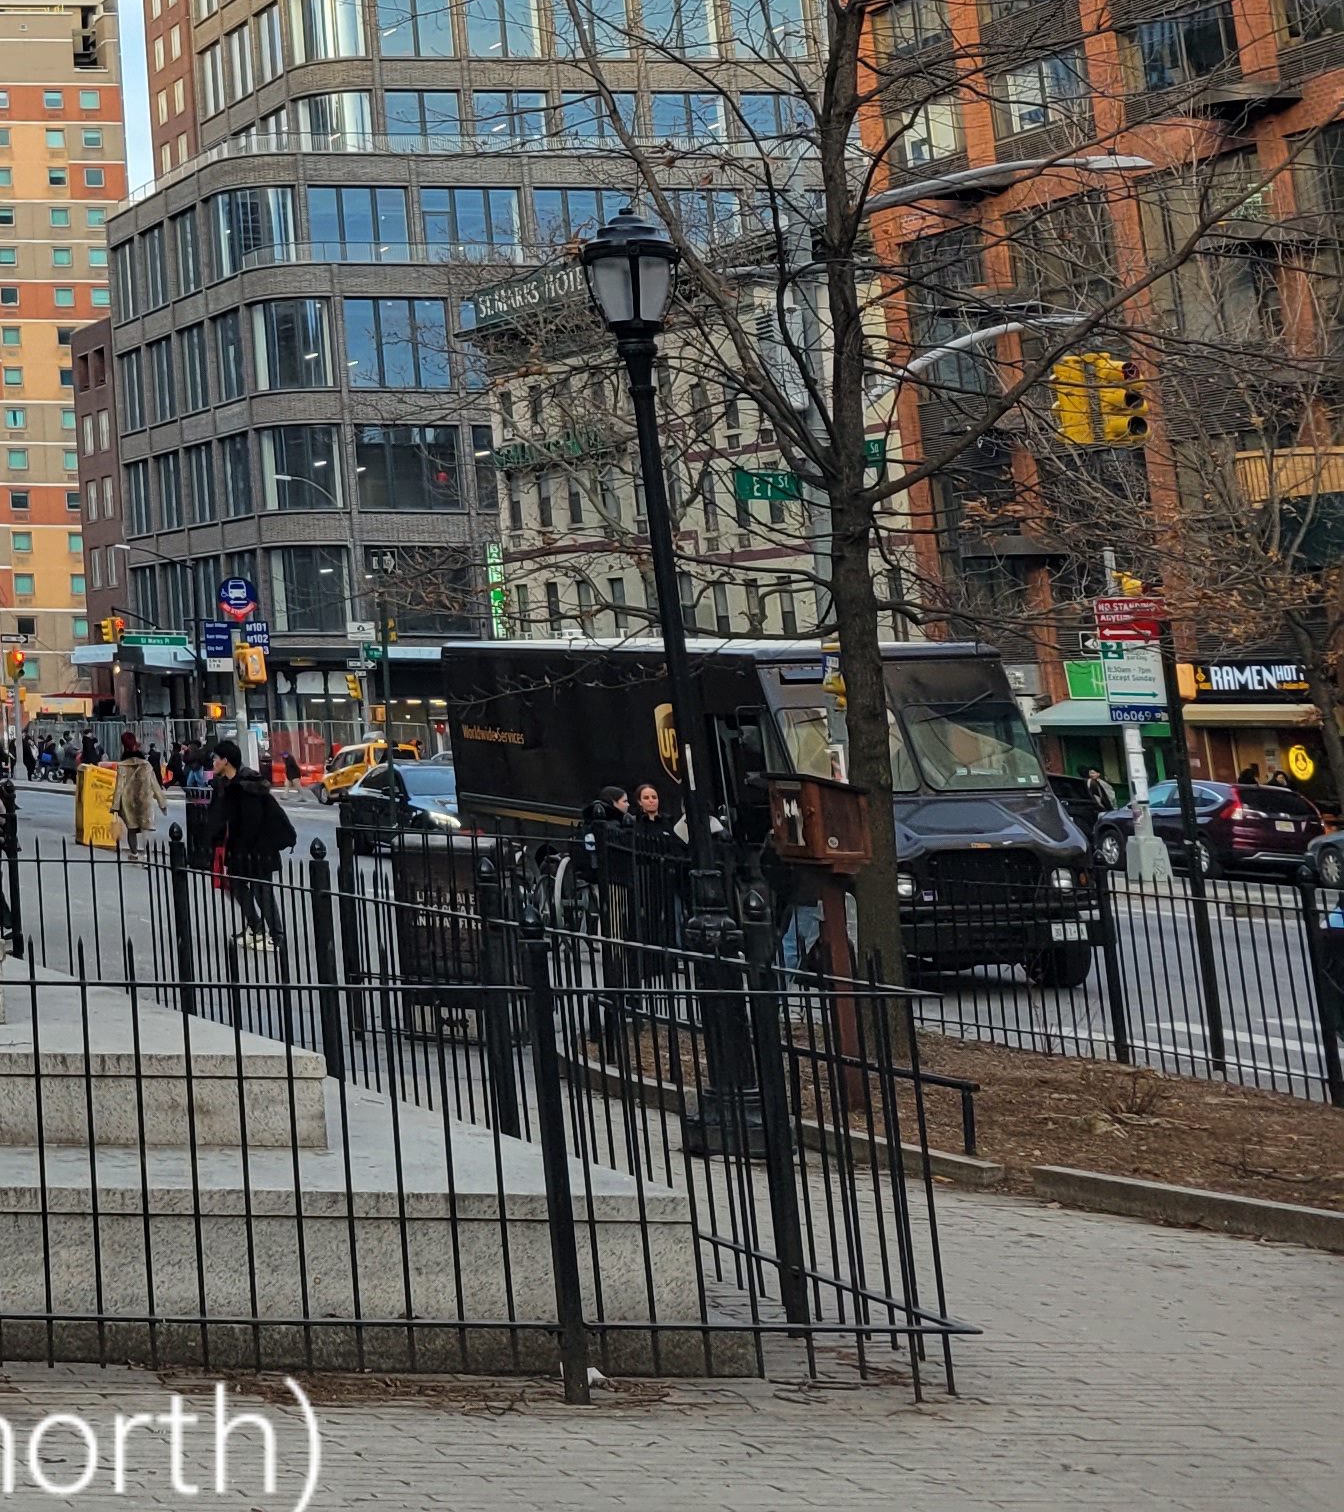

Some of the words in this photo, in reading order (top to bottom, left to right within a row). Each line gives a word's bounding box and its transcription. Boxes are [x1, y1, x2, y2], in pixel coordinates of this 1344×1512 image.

[544, 265, 593, 299] HOTE
[246, 623, 267, 632] M101
[247, 635, 269, 643] M102
[1108, 674, 1131, 682] Except
[1210, 666, 1278, 690] RAMEN
